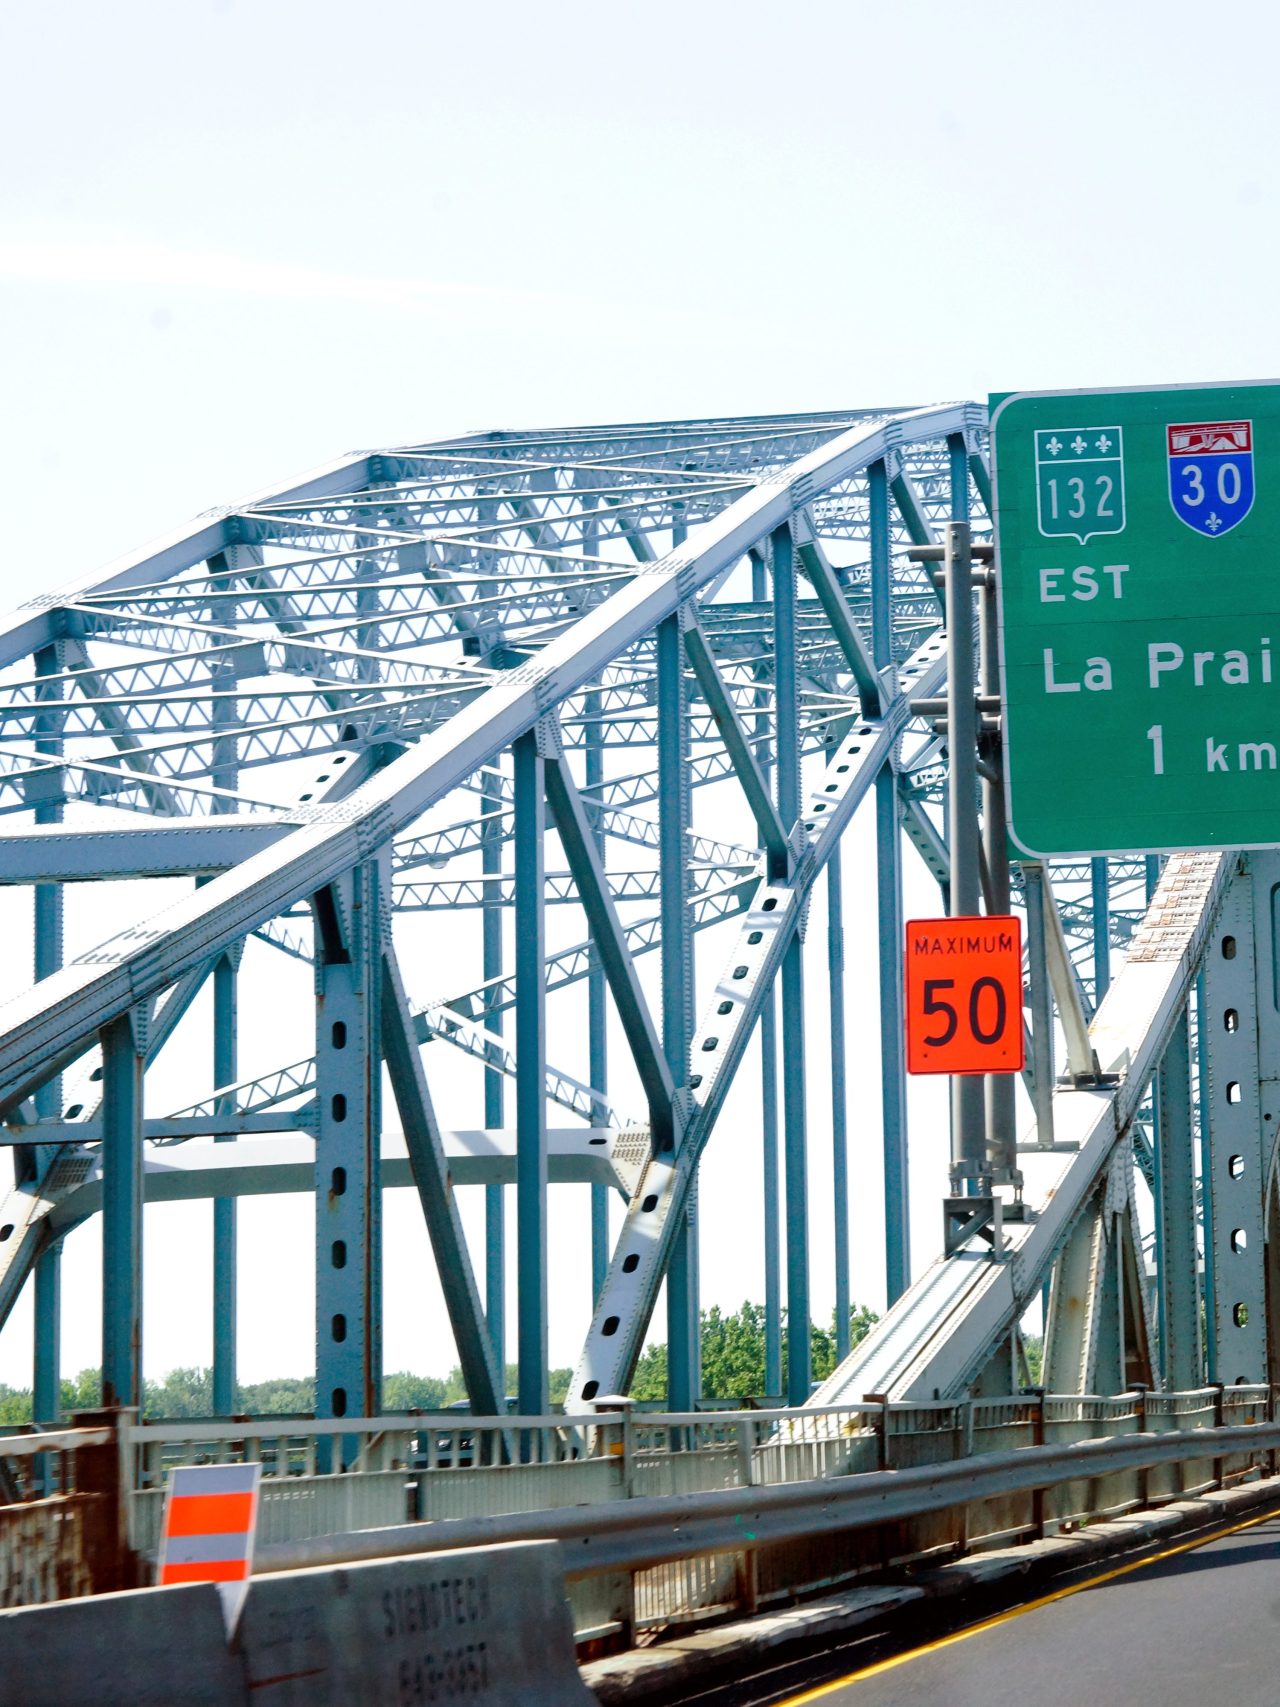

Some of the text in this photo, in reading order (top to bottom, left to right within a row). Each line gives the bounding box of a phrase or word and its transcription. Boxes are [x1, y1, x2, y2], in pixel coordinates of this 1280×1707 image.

[1047, 475, 1114, 519] 132
[1181, 462, 1242, 507] 30
[1039, 564, 1130, 603] EST
[1043, 648, 1113, 694] La
[1146, 724, 1278, 775] 1 km
[914, 934, 1013, 956] MAXIMUM
[922, 975, 1007, 1047] 50
